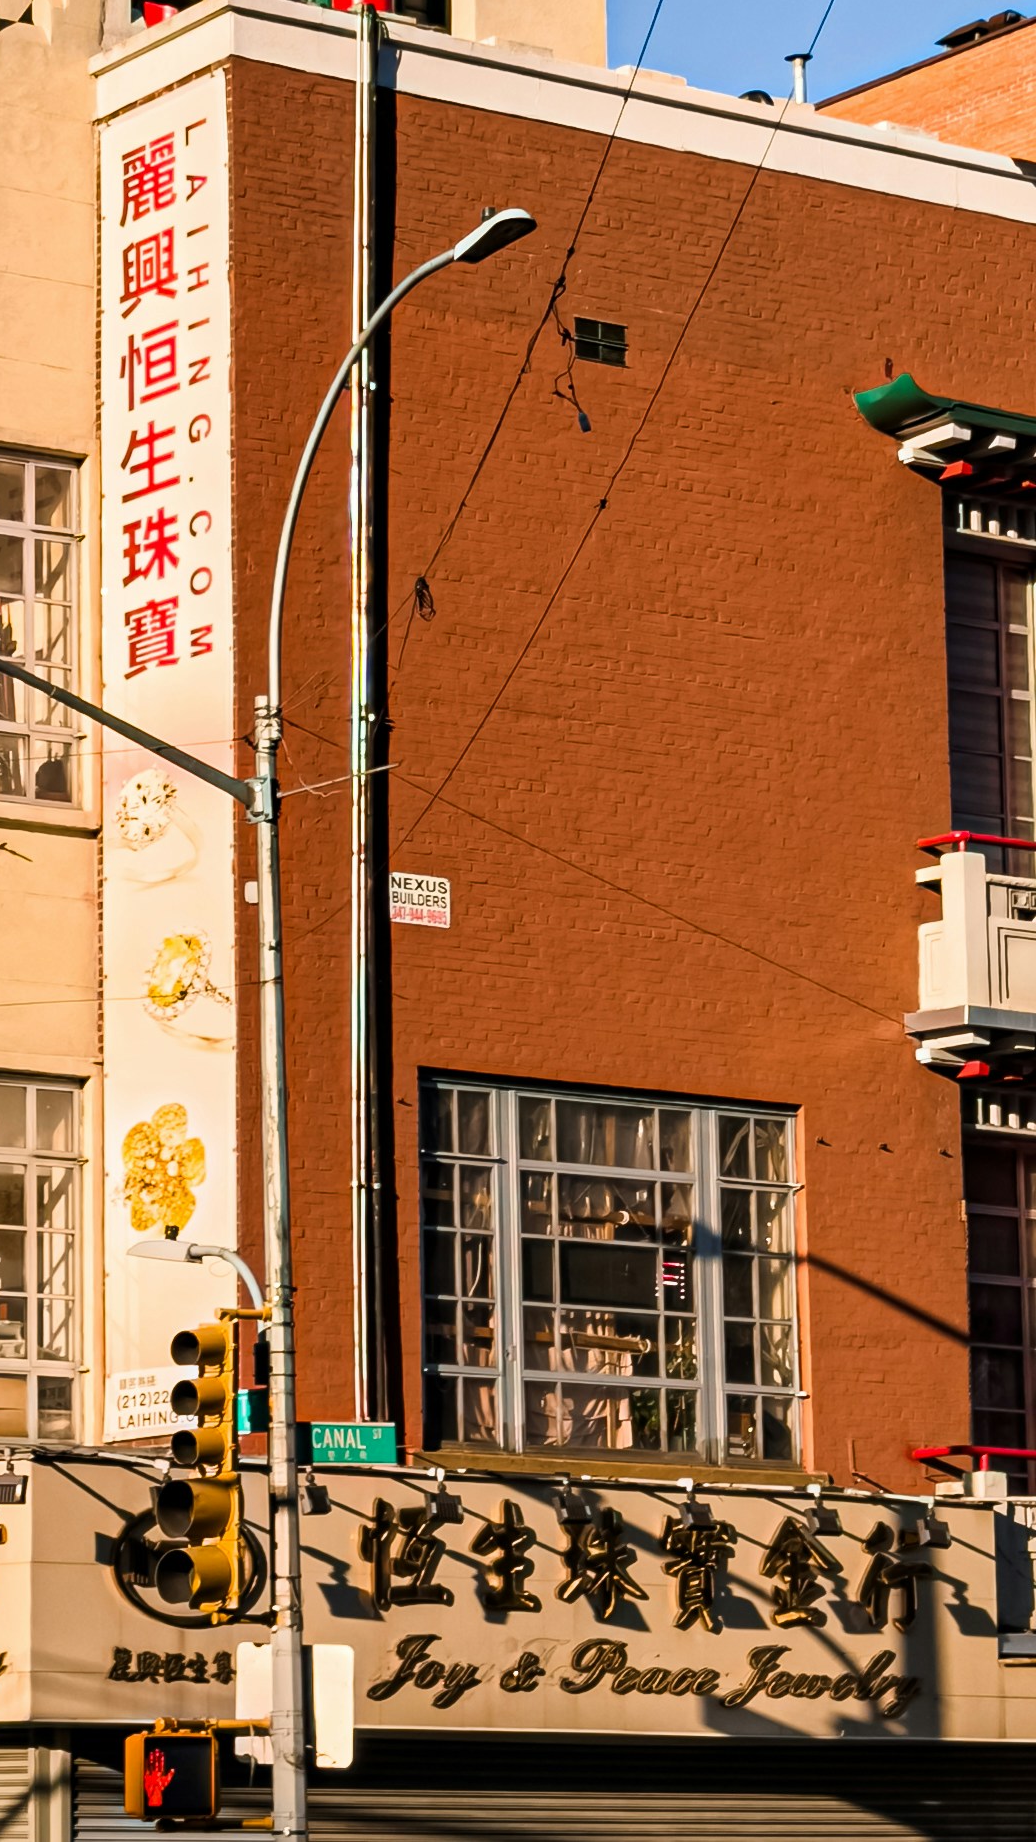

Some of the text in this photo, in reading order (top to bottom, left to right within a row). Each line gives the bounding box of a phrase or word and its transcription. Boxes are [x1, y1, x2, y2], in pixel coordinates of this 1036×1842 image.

[185, 118, 213, 659] LAIHING.COM
[391, 877, 448, 894] NEXUS
[392, 891, 447, 909] BUILDERS
[311, 1427, 367, 1450] CANAL
[366, 1634, 921, 1718] Joy & Peace Jewelry
